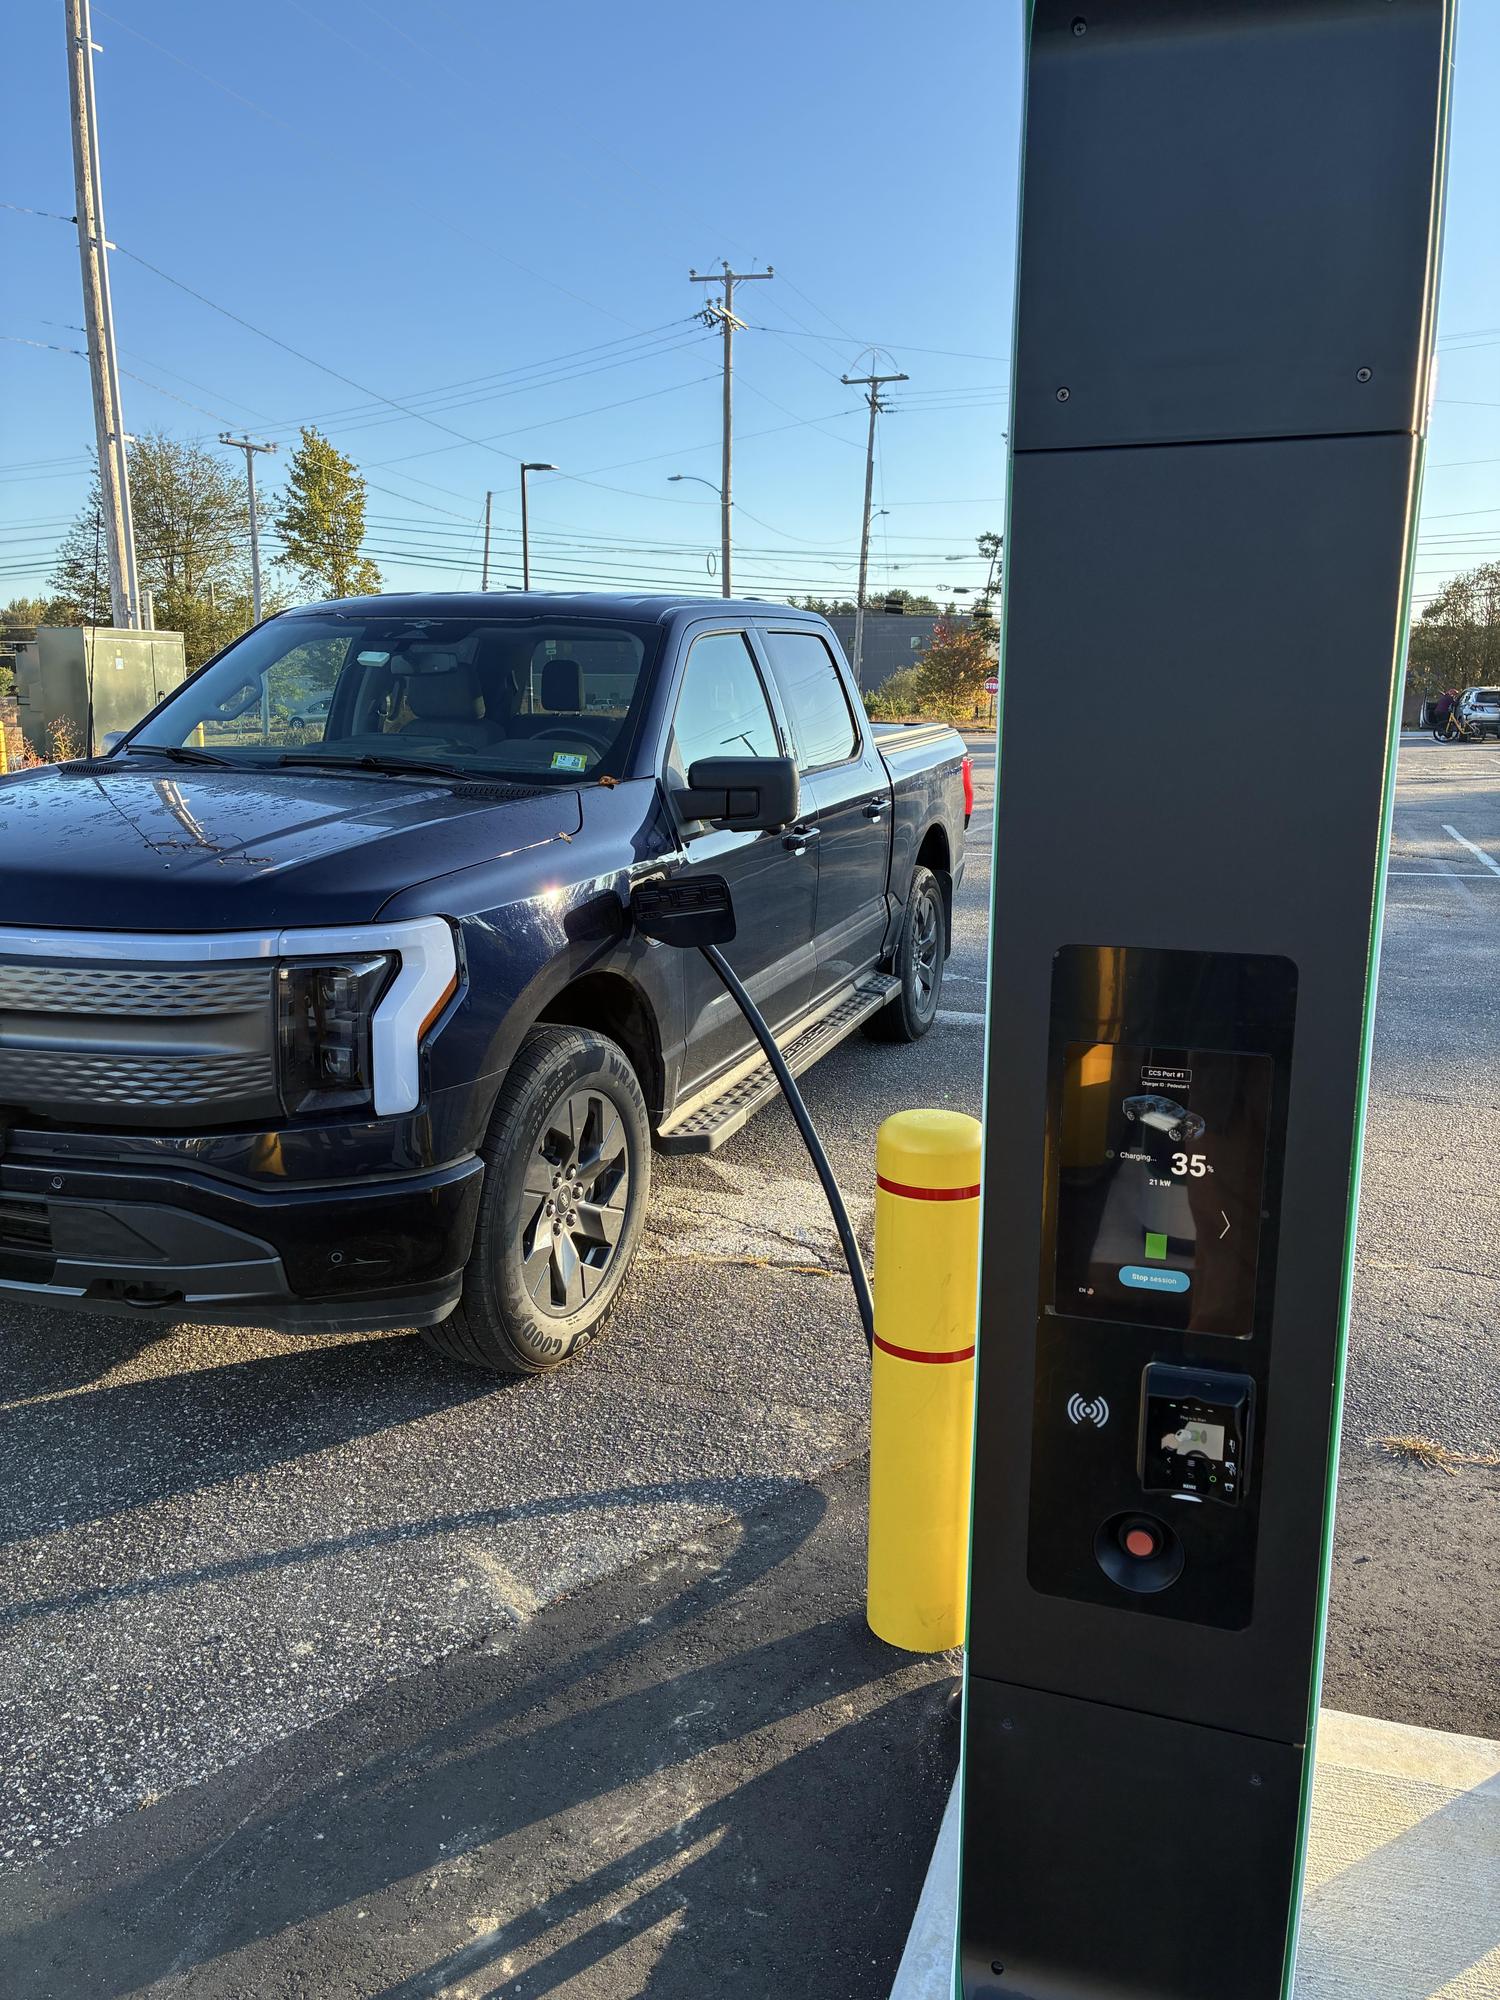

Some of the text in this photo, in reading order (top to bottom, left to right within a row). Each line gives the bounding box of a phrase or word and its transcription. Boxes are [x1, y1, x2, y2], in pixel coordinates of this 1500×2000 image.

[1159, 1179, 1172, 1187] kW
[1131, 1273, 1177, 1285] Stop session
